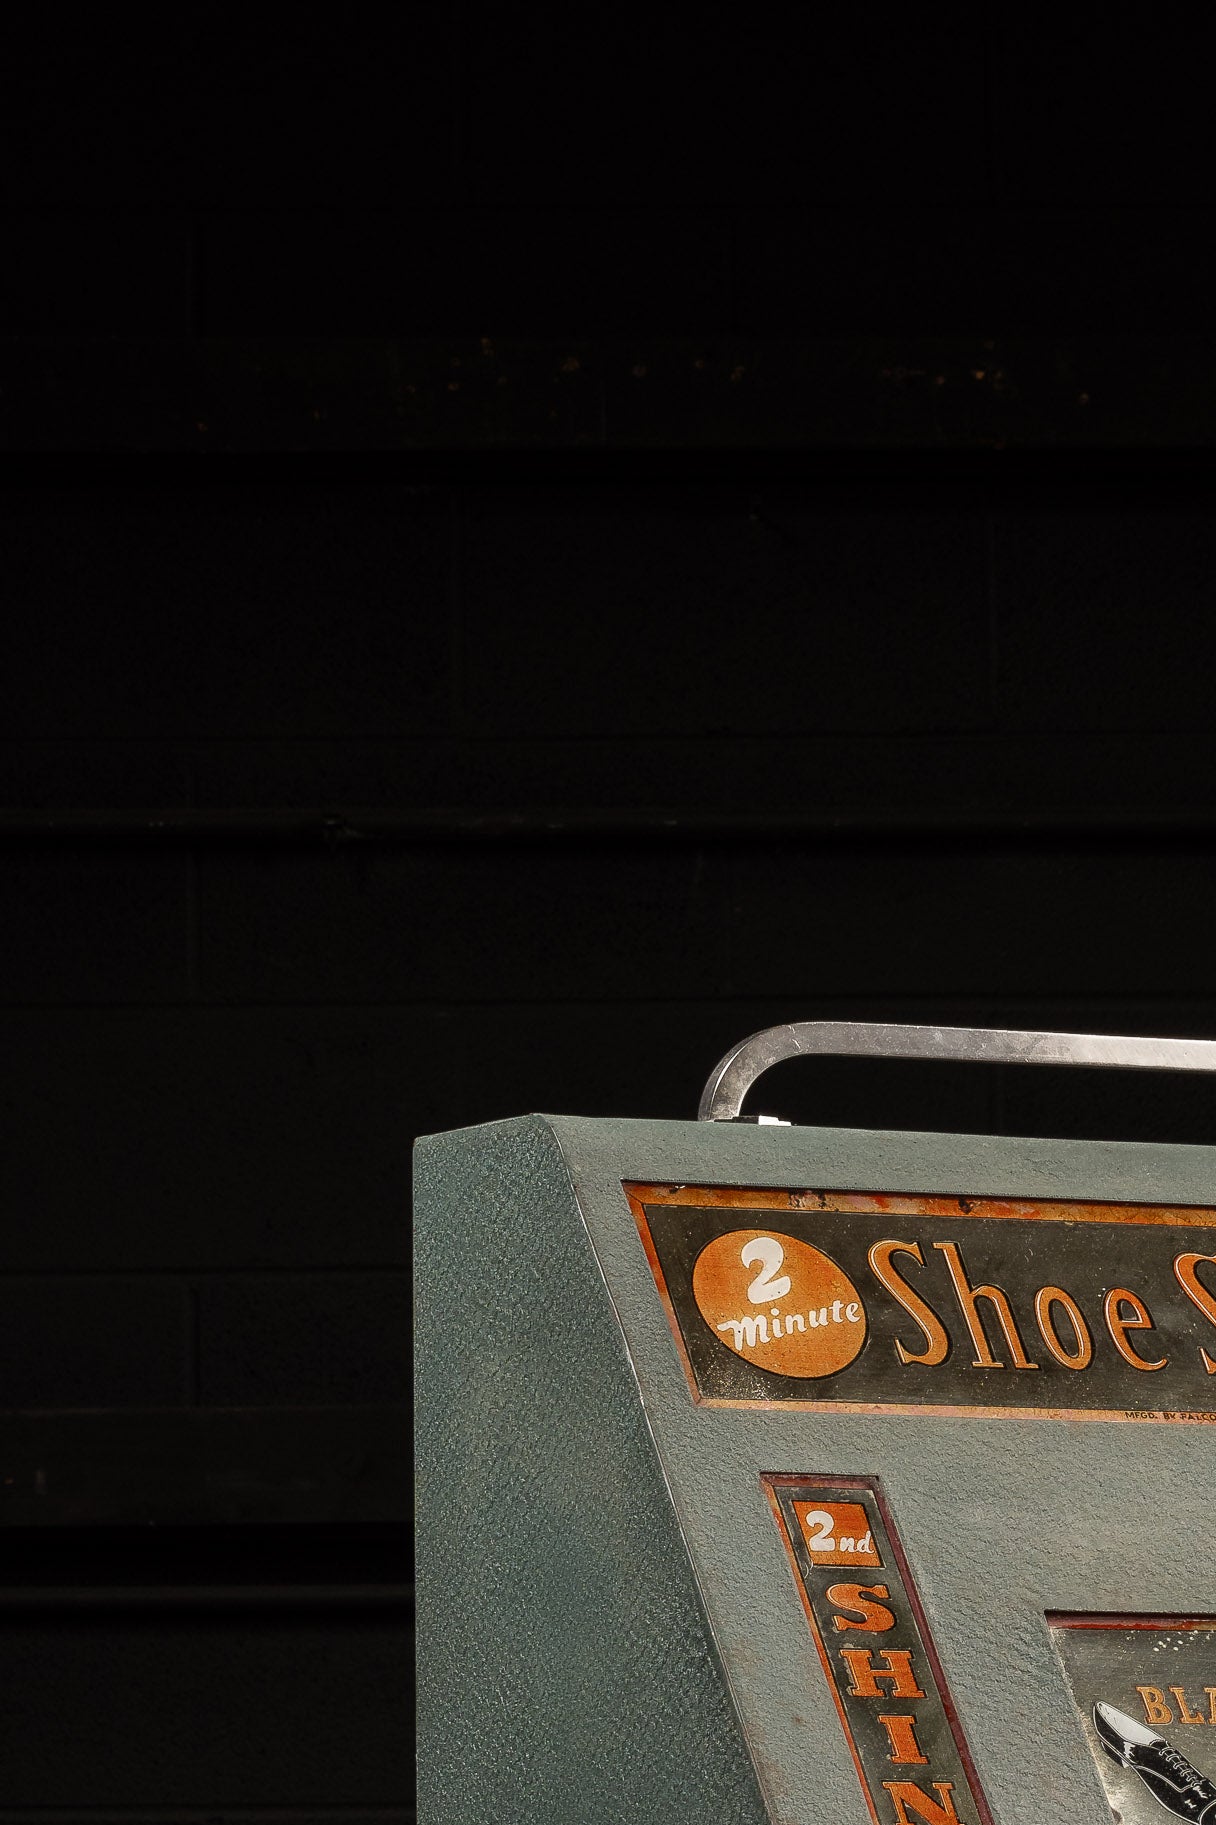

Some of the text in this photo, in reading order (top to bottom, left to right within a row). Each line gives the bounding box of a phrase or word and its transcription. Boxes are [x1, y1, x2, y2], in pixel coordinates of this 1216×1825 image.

[741, 1237, 791, 1305] 2
[717, 1300, 861, 1350] Minute
[868, 1239, 1168, 1371] Shoe
[1124, 1410, 1158, 1420] MFGD.
[1163, 1412, 1176, 1421] BY
[806, 1510, 873, 1555] 2nd
